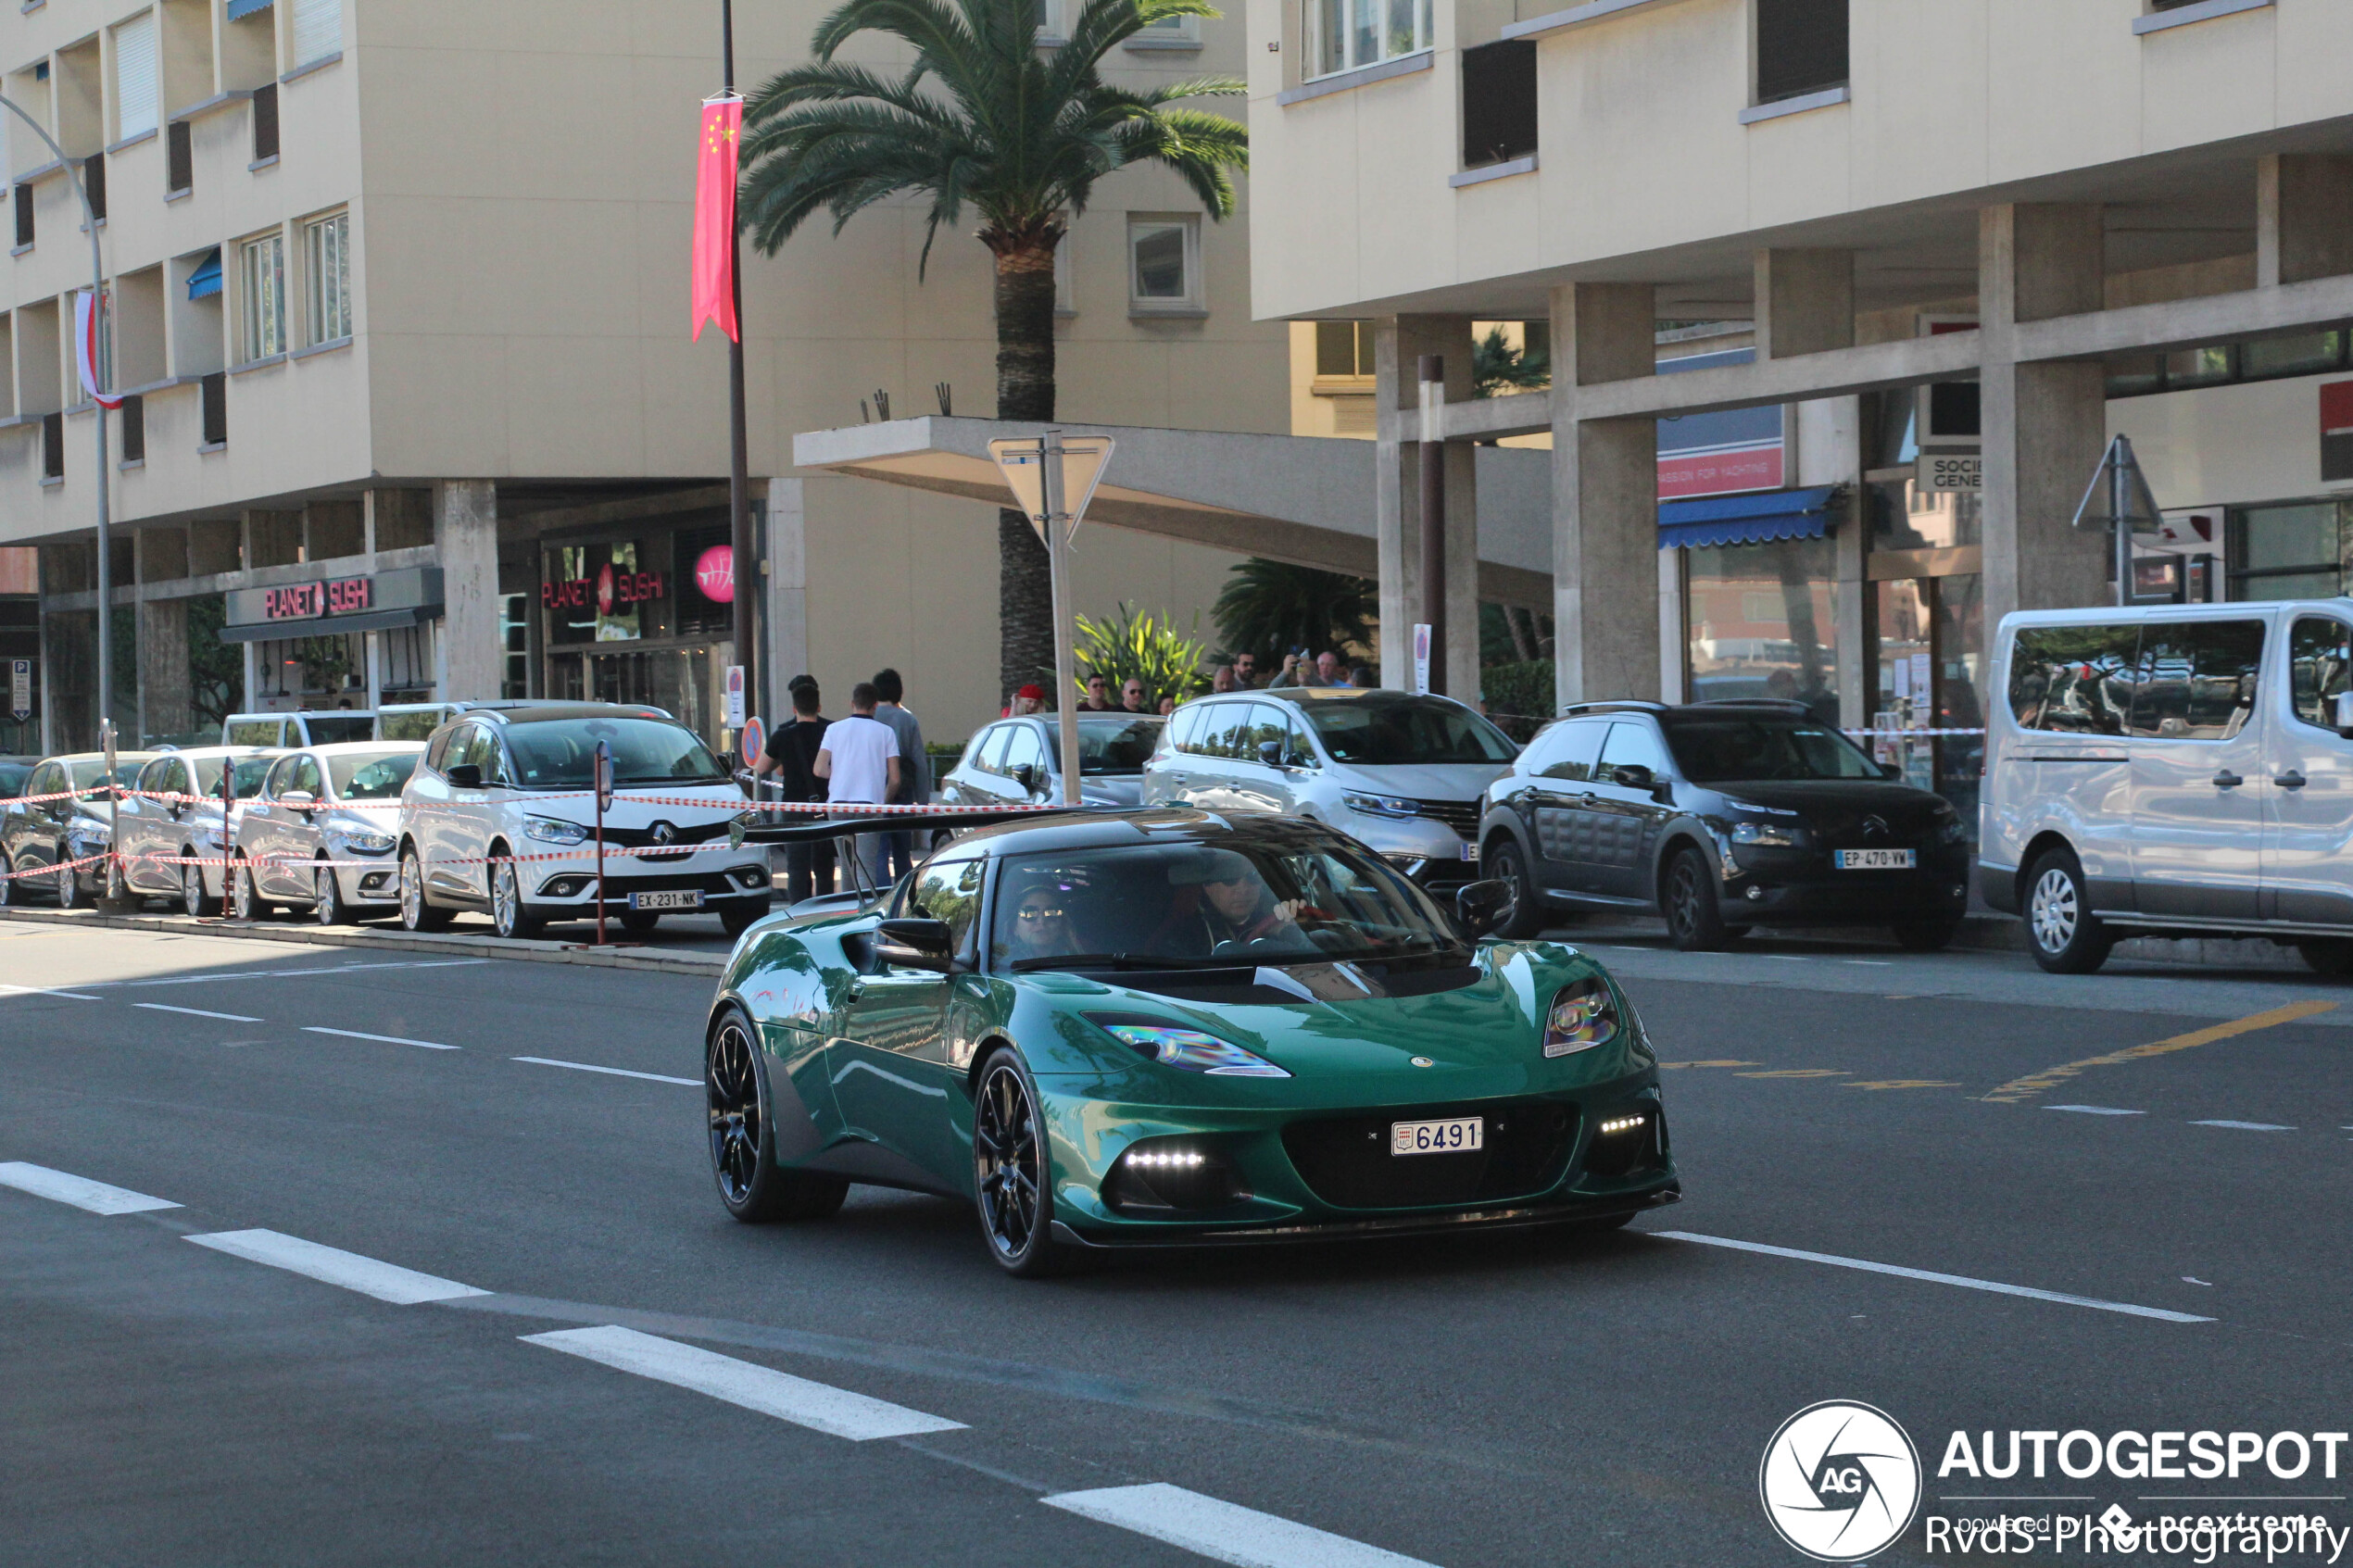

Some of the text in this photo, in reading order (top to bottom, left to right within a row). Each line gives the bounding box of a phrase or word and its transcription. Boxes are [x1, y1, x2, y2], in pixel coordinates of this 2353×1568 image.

[265, 579, 369, 619] PLANET SUSHI
[542, 572, 663, 608] PLANET SUSHI
[18, 662, 25, 672] P
[638, 893, 696, 907] EX-231-NK
[1416, 1123, 1475, 1149] 6491
